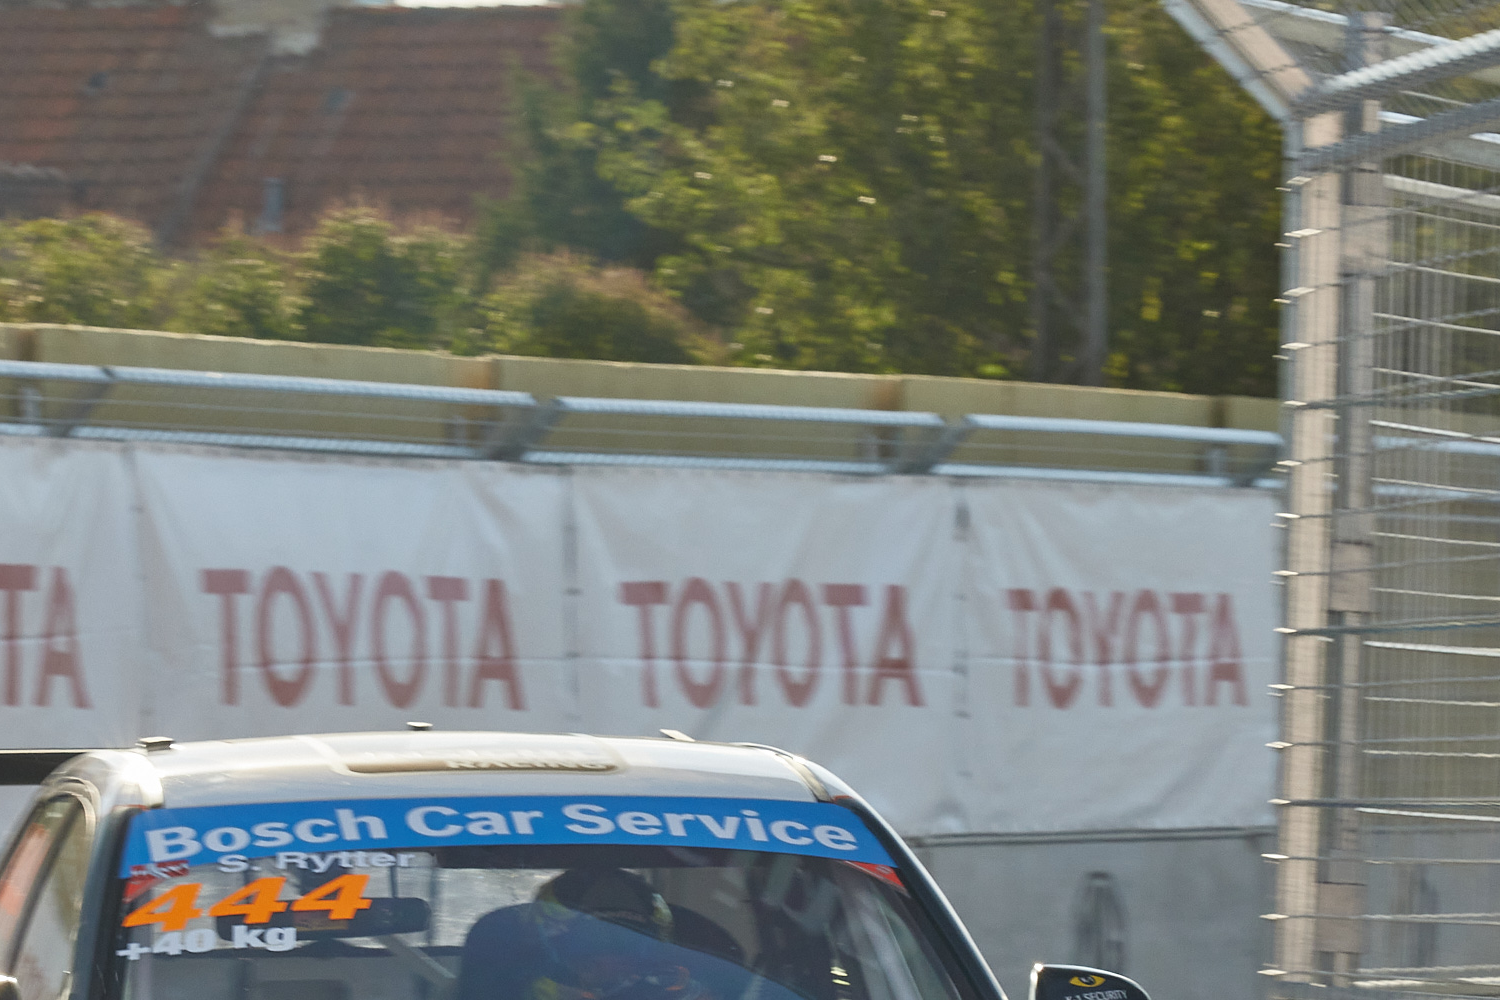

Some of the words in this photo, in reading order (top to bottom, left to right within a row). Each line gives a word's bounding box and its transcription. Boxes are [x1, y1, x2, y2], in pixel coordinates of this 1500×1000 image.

[200, 565, 527, 711] TOYOTA
[619, 576, 927, 708] TOYOTA
[1005, 587, 1250, 709] TOYOTA
[145, 808, 388, 861] Bosch
[405, 805, 544, 837] Car
[562, 803, 859, 851] Service
[215, 853, 262, 874] S.
[275, 851, 417, 874] Rytter
[121, 873, 373, 932] 444
[231, 925, 298, 952] kg
